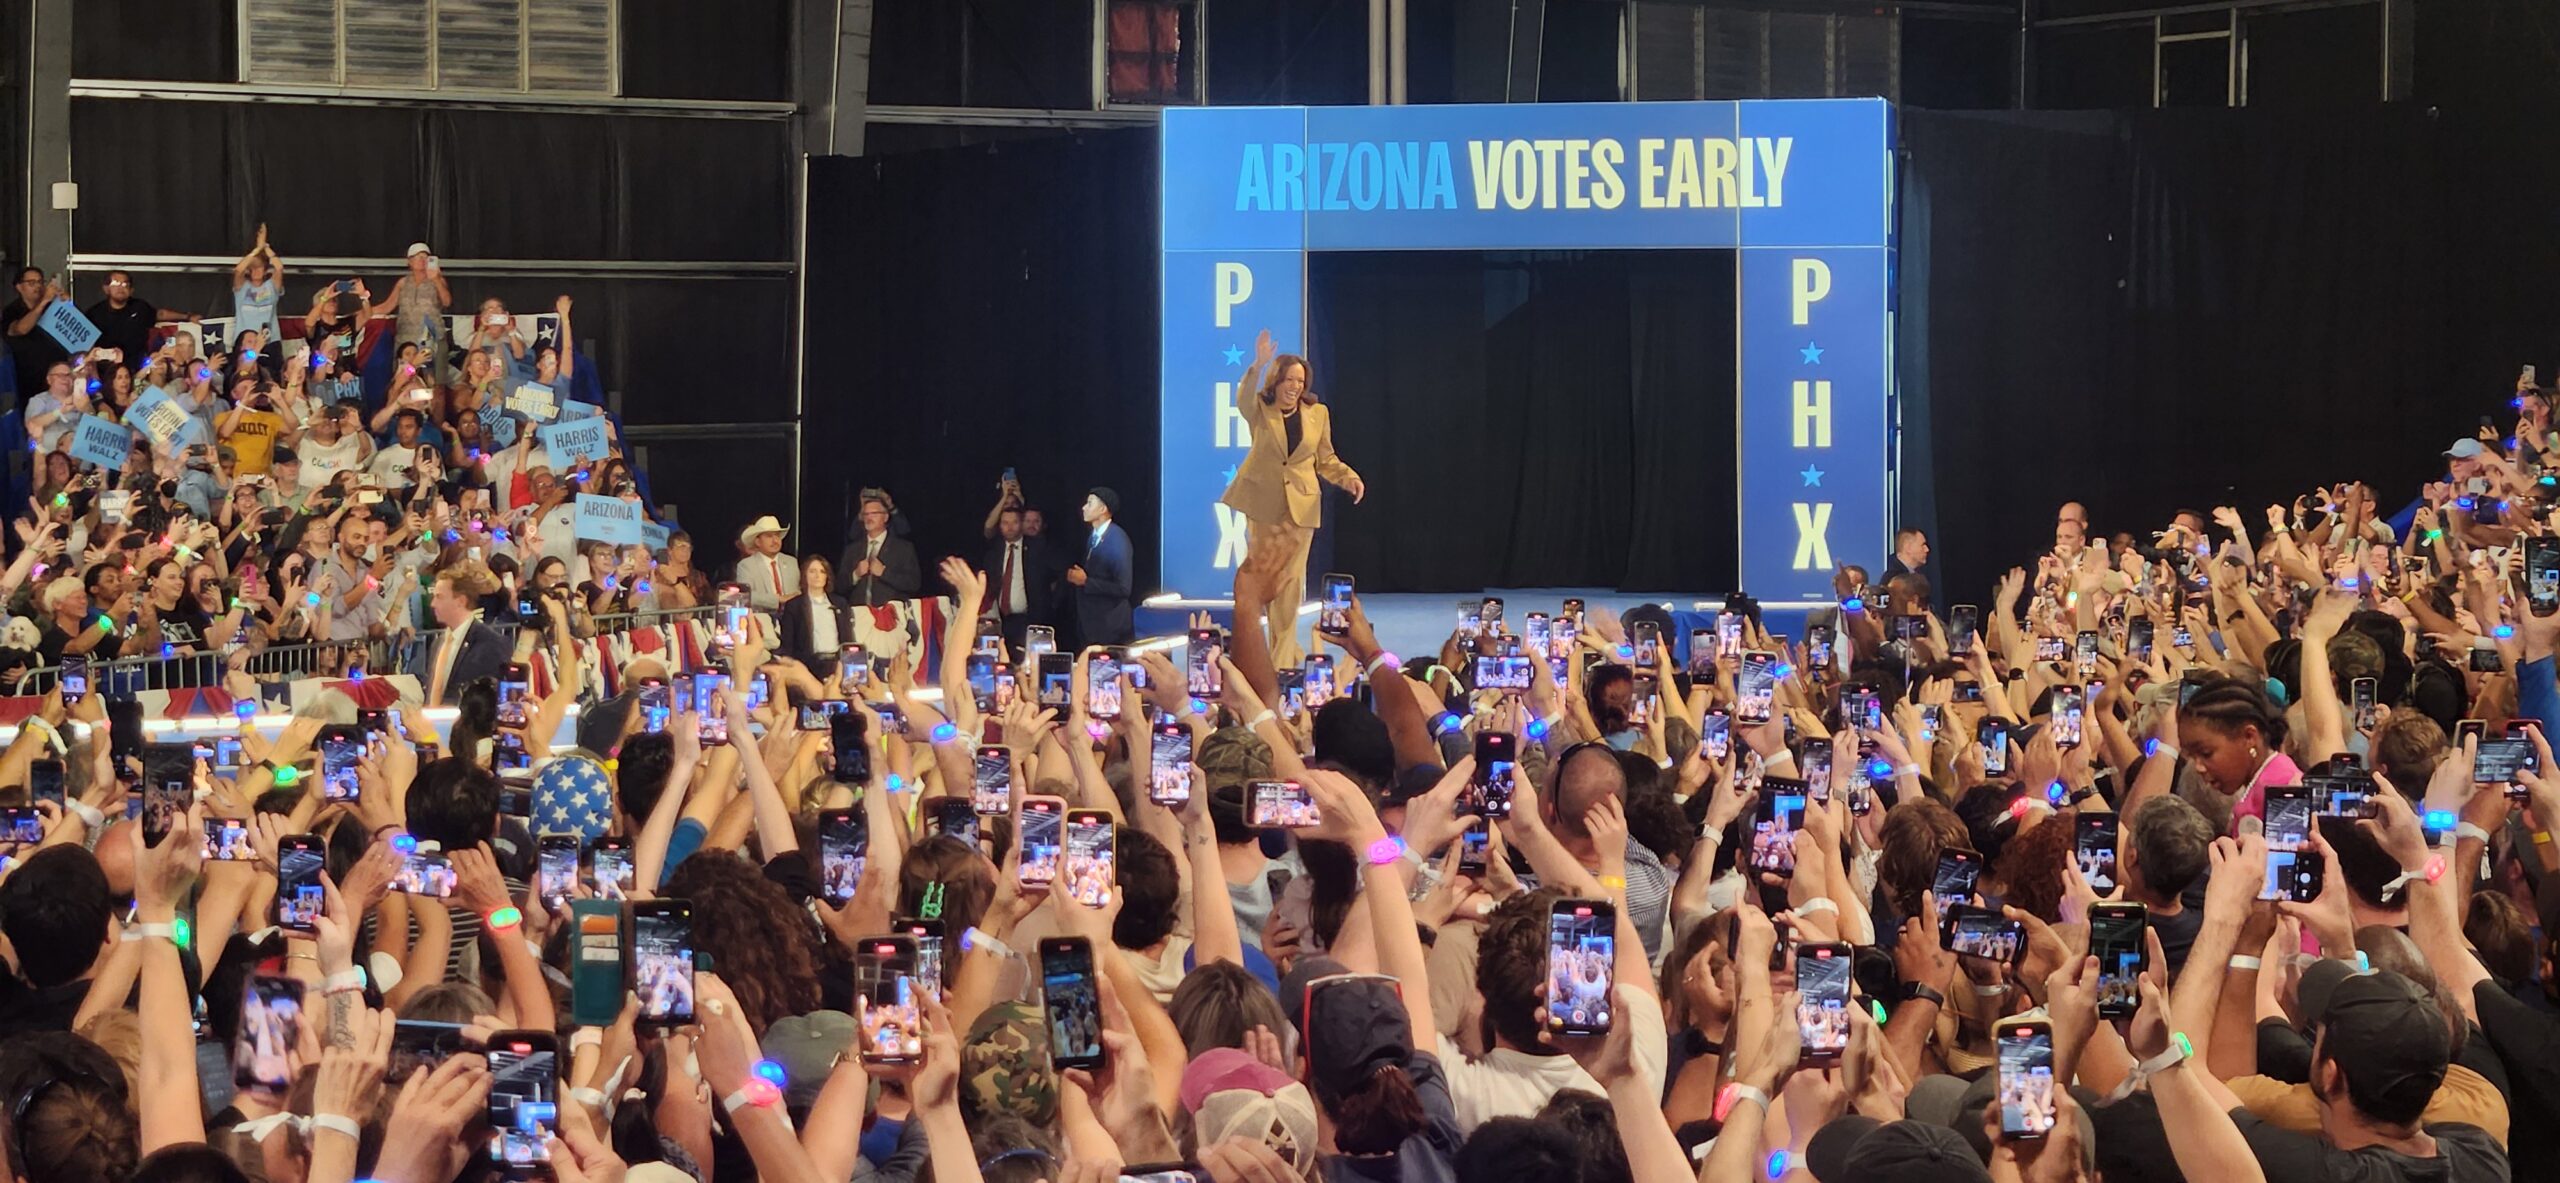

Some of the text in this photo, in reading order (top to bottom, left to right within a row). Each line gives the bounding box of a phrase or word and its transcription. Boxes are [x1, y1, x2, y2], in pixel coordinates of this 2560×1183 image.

[1235, 137, 1794, 211] ARIZONA VOTES EARLY
[54, 306, 91, 342] HARRIS
[55, 322, 78, 345] WALZ
[150, 400, 186, 430] ARIZONA
[85, 426, 128, 452] HARRIS
[555, 426, 599, 448] HARRIS
[89, 444, 119, 460] WALZ
[565, 443, 594, 456] WALZ
[583, 501, 634, 520] ARIZONA
